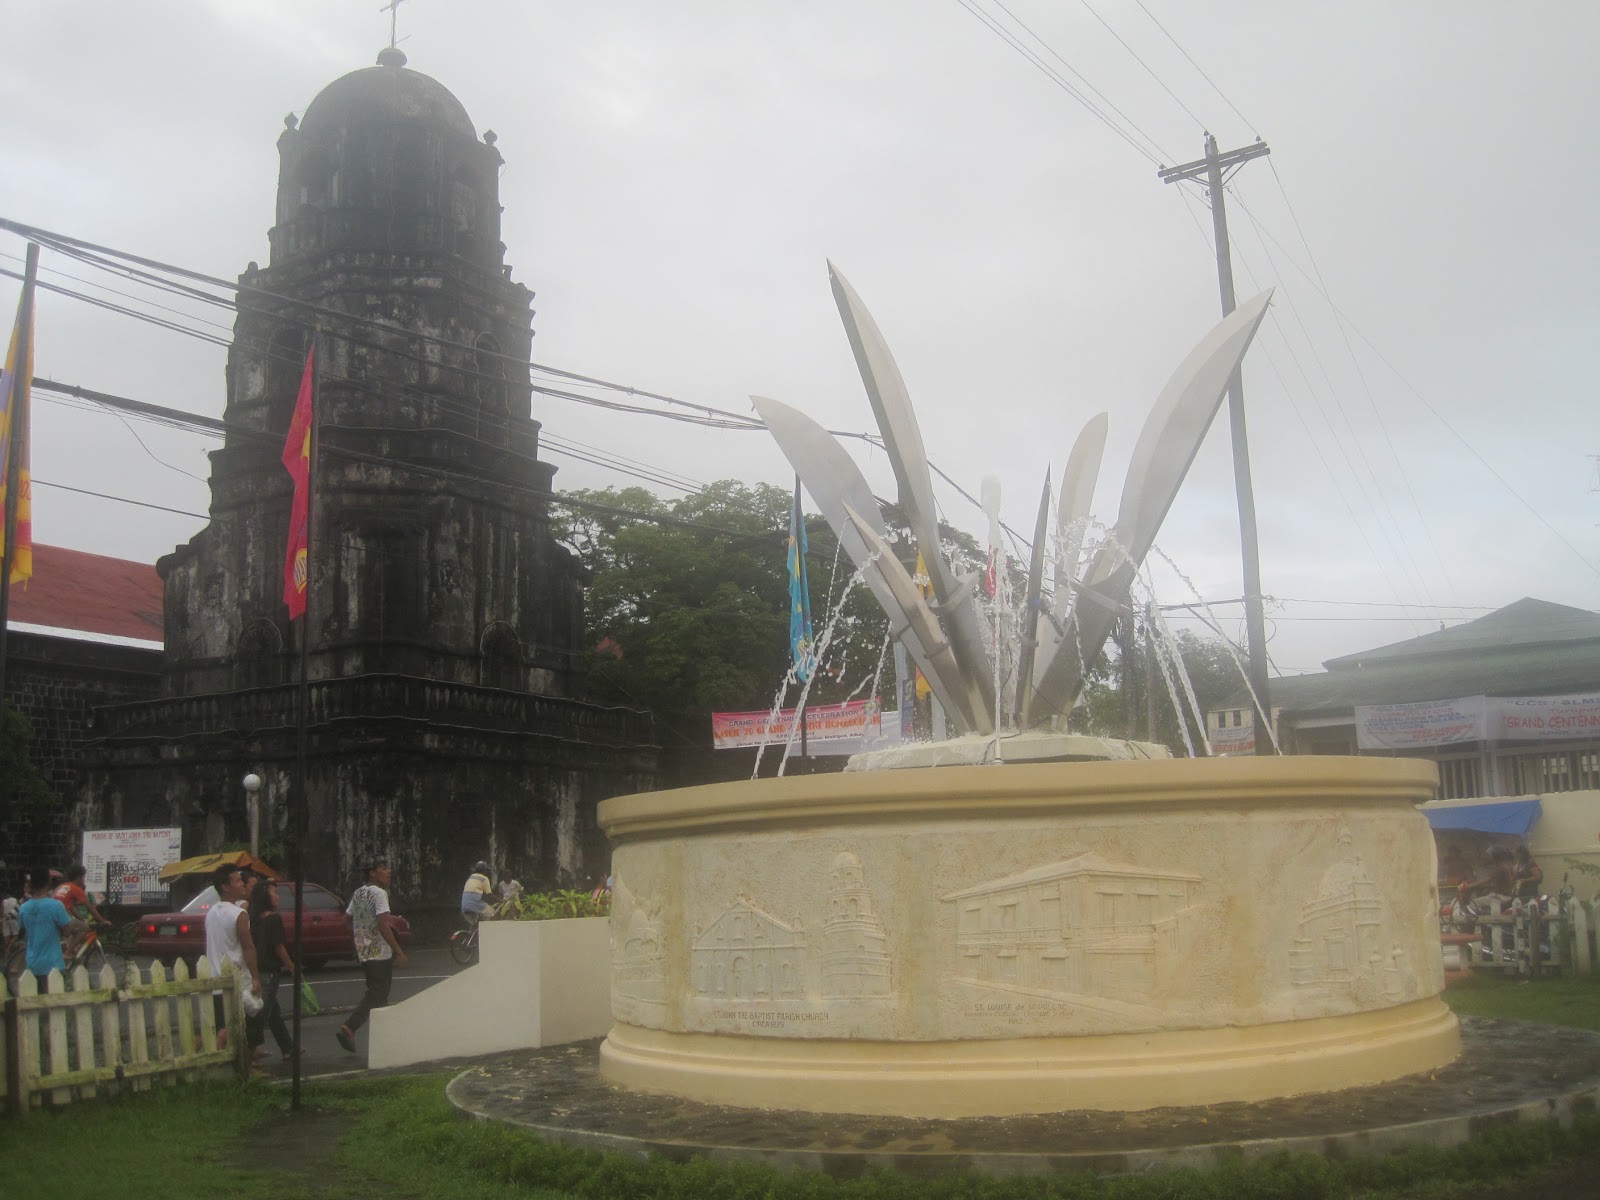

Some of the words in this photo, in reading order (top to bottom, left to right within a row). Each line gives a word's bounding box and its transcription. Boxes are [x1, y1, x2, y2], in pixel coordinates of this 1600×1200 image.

[728, 719, 754, 727] GRAND
[806, 709, 859, 720] CELEBRATION
[123, 876, 140, 884] NO
[987, 1003, 1012, 1011] LOUISE
[749, 1011, 775, 1020] BAPTIST
[777, 1012, 800, 1020] PARISH
[801, 1012, 829, 1021] CHURCH
